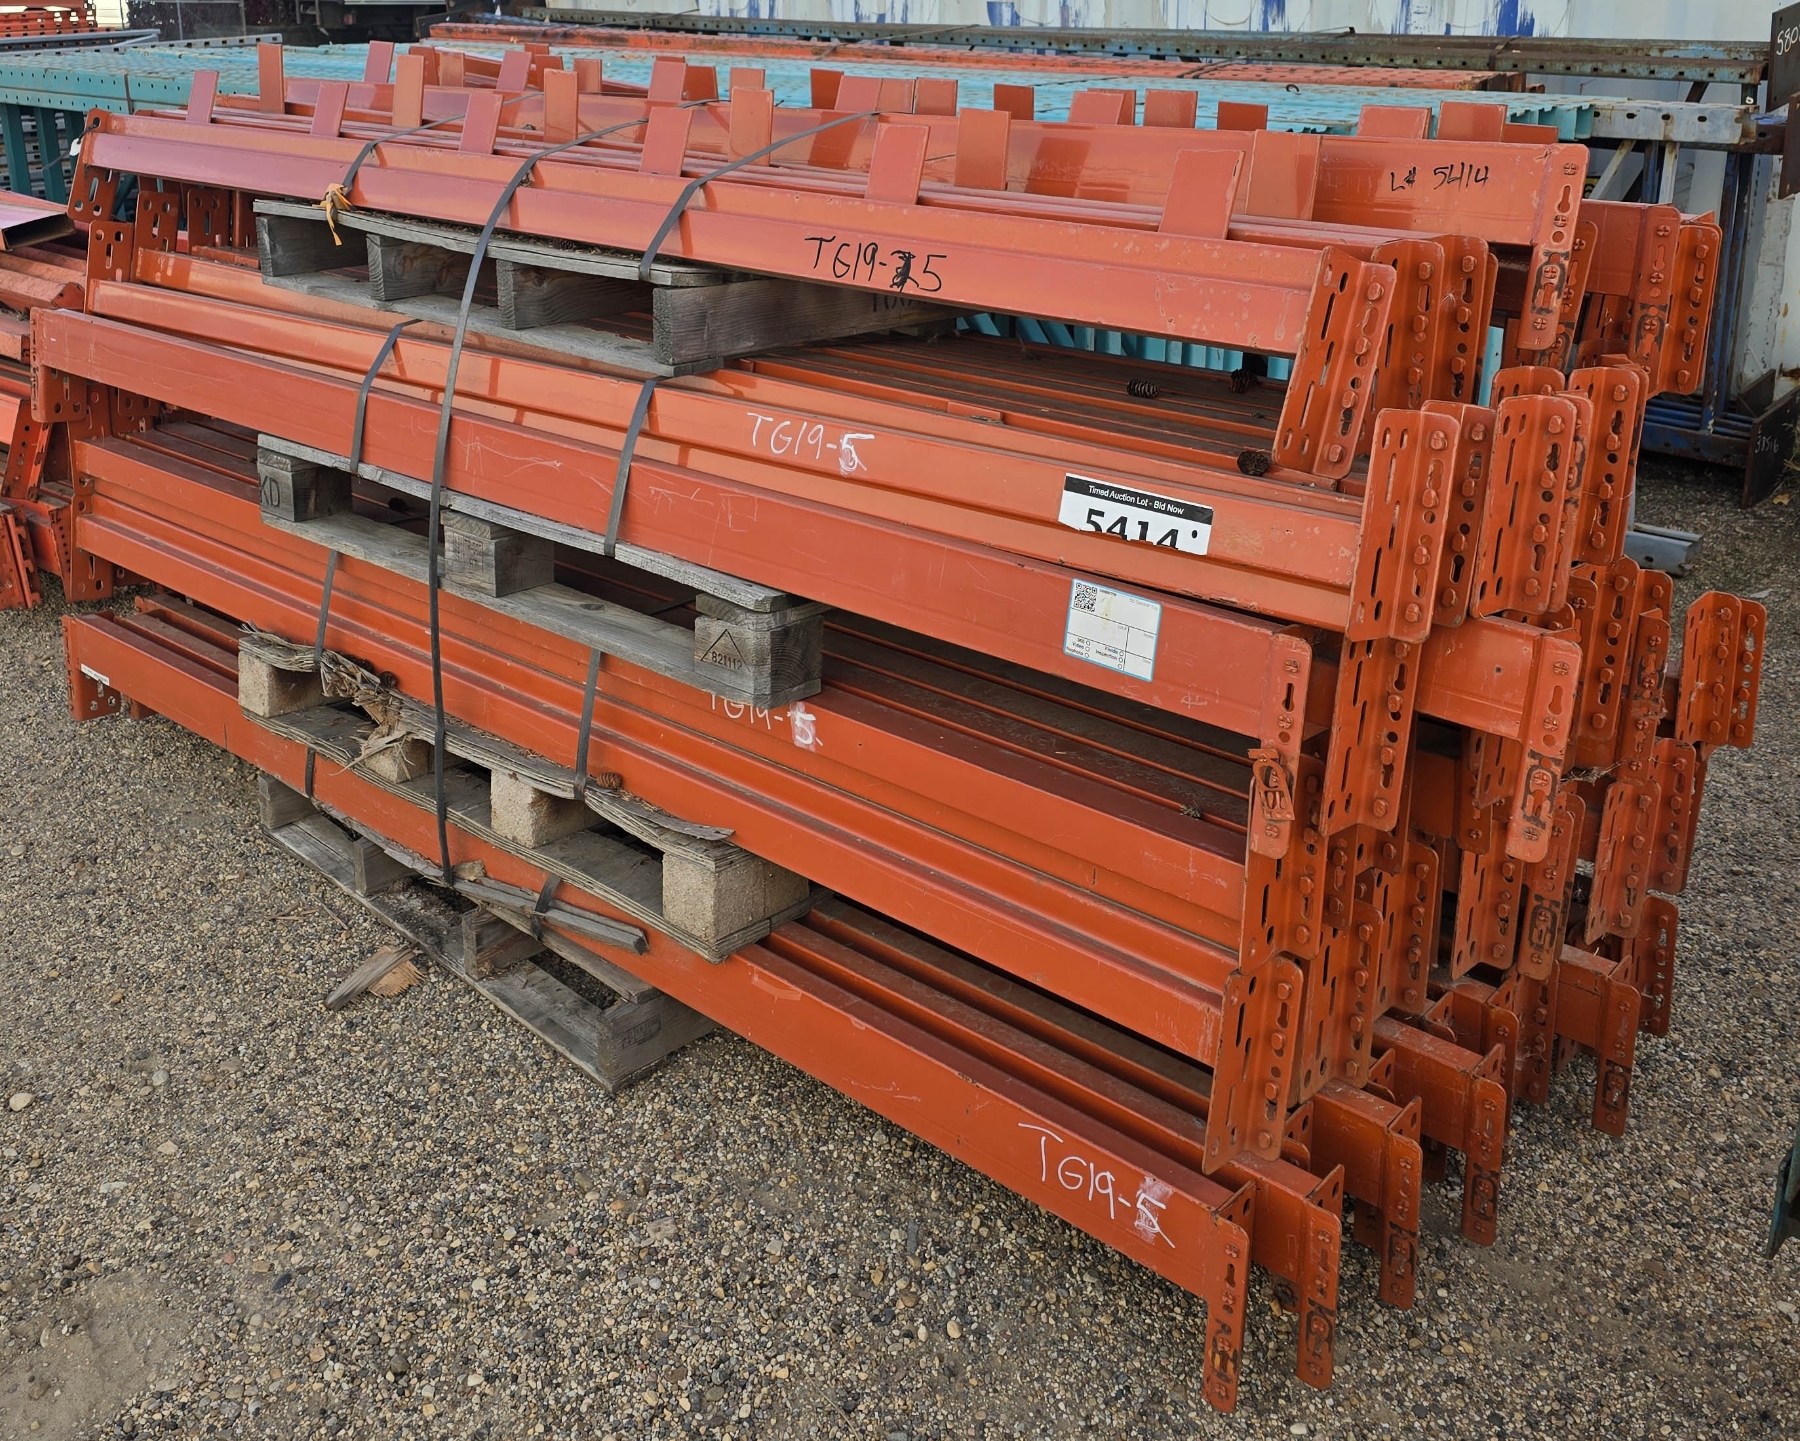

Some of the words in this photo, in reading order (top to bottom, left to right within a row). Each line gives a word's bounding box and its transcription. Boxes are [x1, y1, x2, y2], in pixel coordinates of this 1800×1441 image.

[1776, 23, 1800, 55] 580
[1433, 162, 1489, 191] 5414
[1089, 485, 1109, 497] Timed
[1109, 490, 1135, 504] Auction
[1136, 496, 1149, 506] Lot
[1154, 500, 1166, 511] Bid
[1167, 503, 1185, 515] Now
[1086, 507, 1179, 550] 5414
[1018, 1122, 1175, 1248] TG19-5
